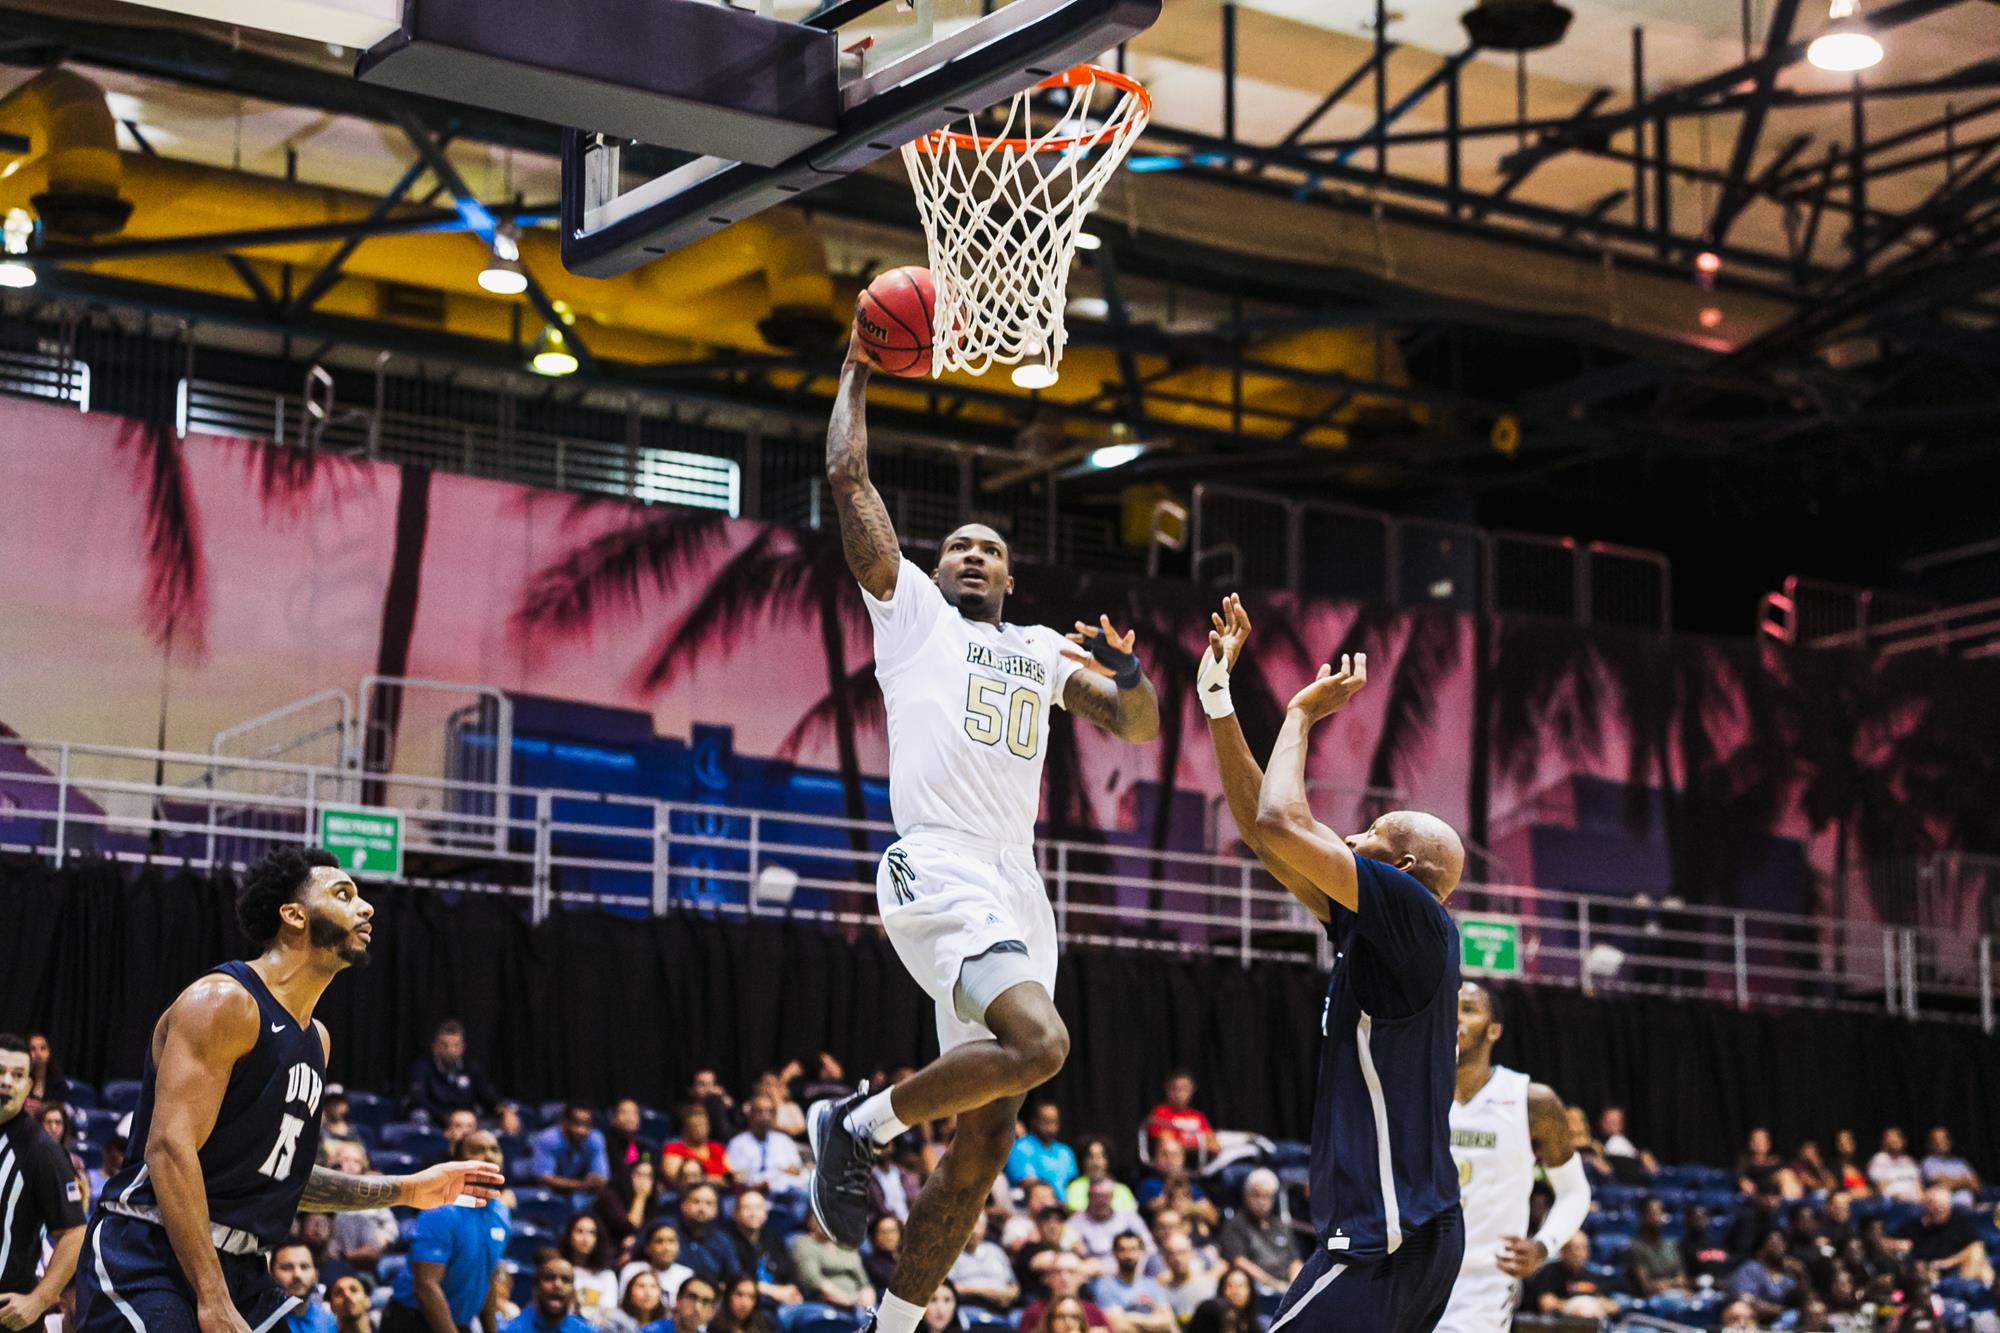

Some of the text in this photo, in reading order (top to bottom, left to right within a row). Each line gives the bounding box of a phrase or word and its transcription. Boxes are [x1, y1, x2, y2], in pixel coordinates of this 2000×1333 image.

[967, 642, 1045, 686] PANTHERS
[964, 673, 1041, 761] 50
[257, 1112, 305, 1182] 15
